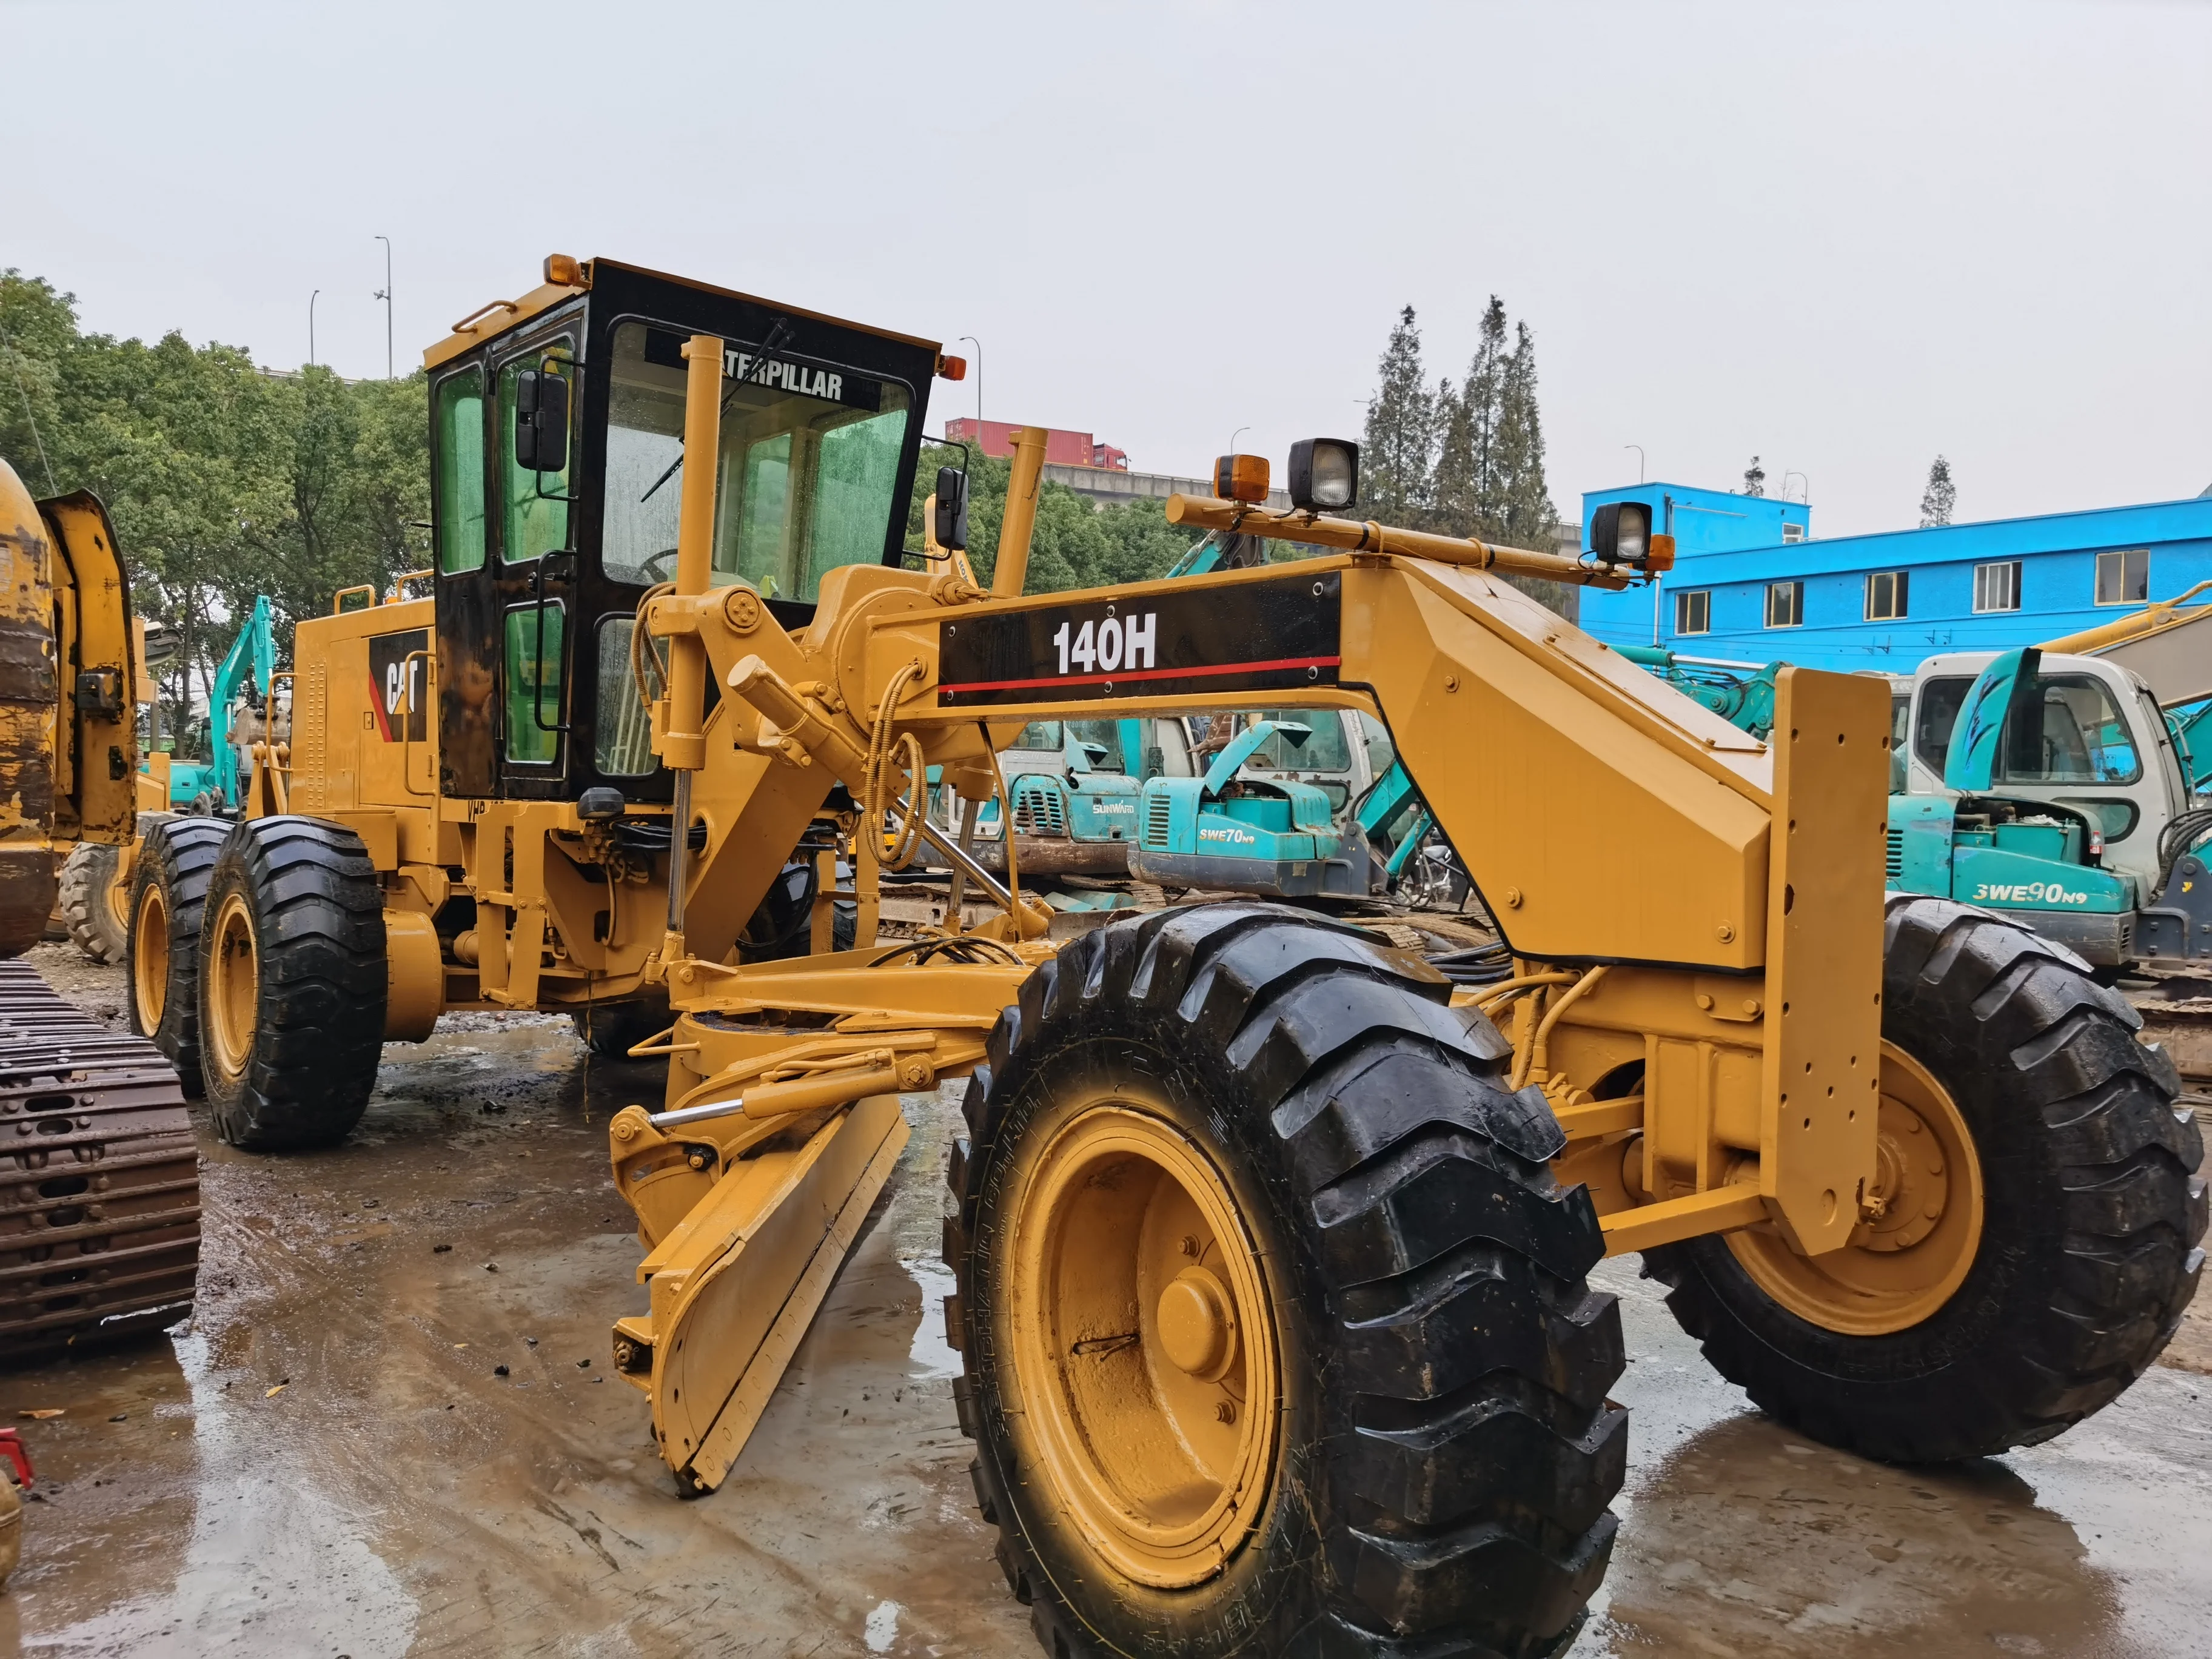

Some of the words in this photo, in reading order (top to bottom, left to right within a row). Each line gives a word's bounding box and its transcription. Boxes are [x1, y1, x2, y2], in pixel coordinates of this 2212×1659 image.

[723, 349, 843, 401] TERPILLAR
[1053, 613, 1156, 674] 140H
[387, 660, 418, 715] CAT
[1093, 799, 1134, 814] SUNWARD
[1199, 828, 1255, 844] SWE70N9
